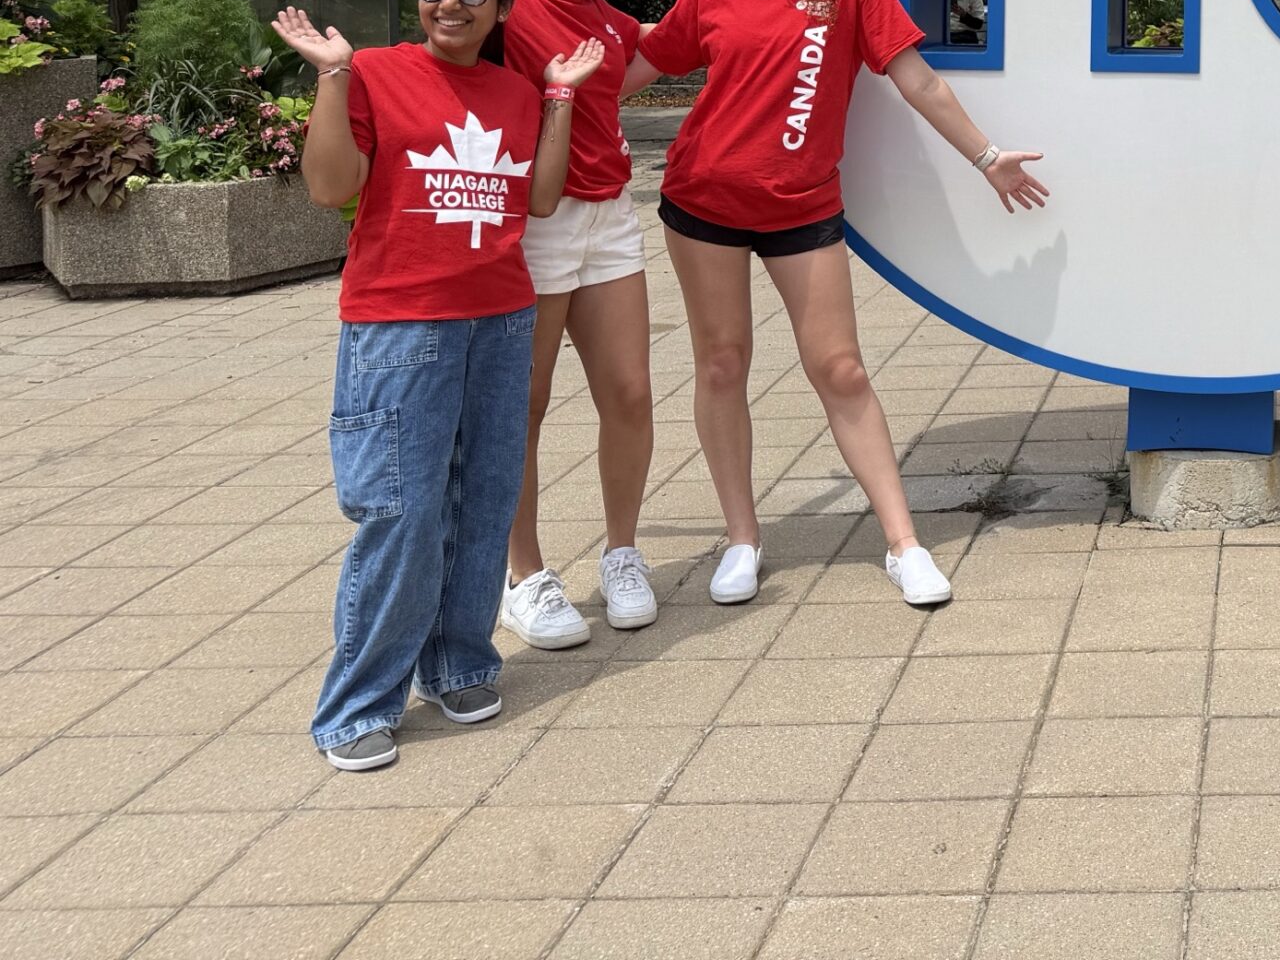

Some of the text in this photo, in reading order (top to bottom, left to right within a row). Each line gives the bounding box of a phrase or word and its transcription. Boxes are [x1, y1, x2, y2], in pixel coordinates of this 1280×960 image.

[782, 25, 828, 150] CANADA
[425, 173, 508, 194] NIAGARA
[429, 191, 505, 210] COLLEGE
